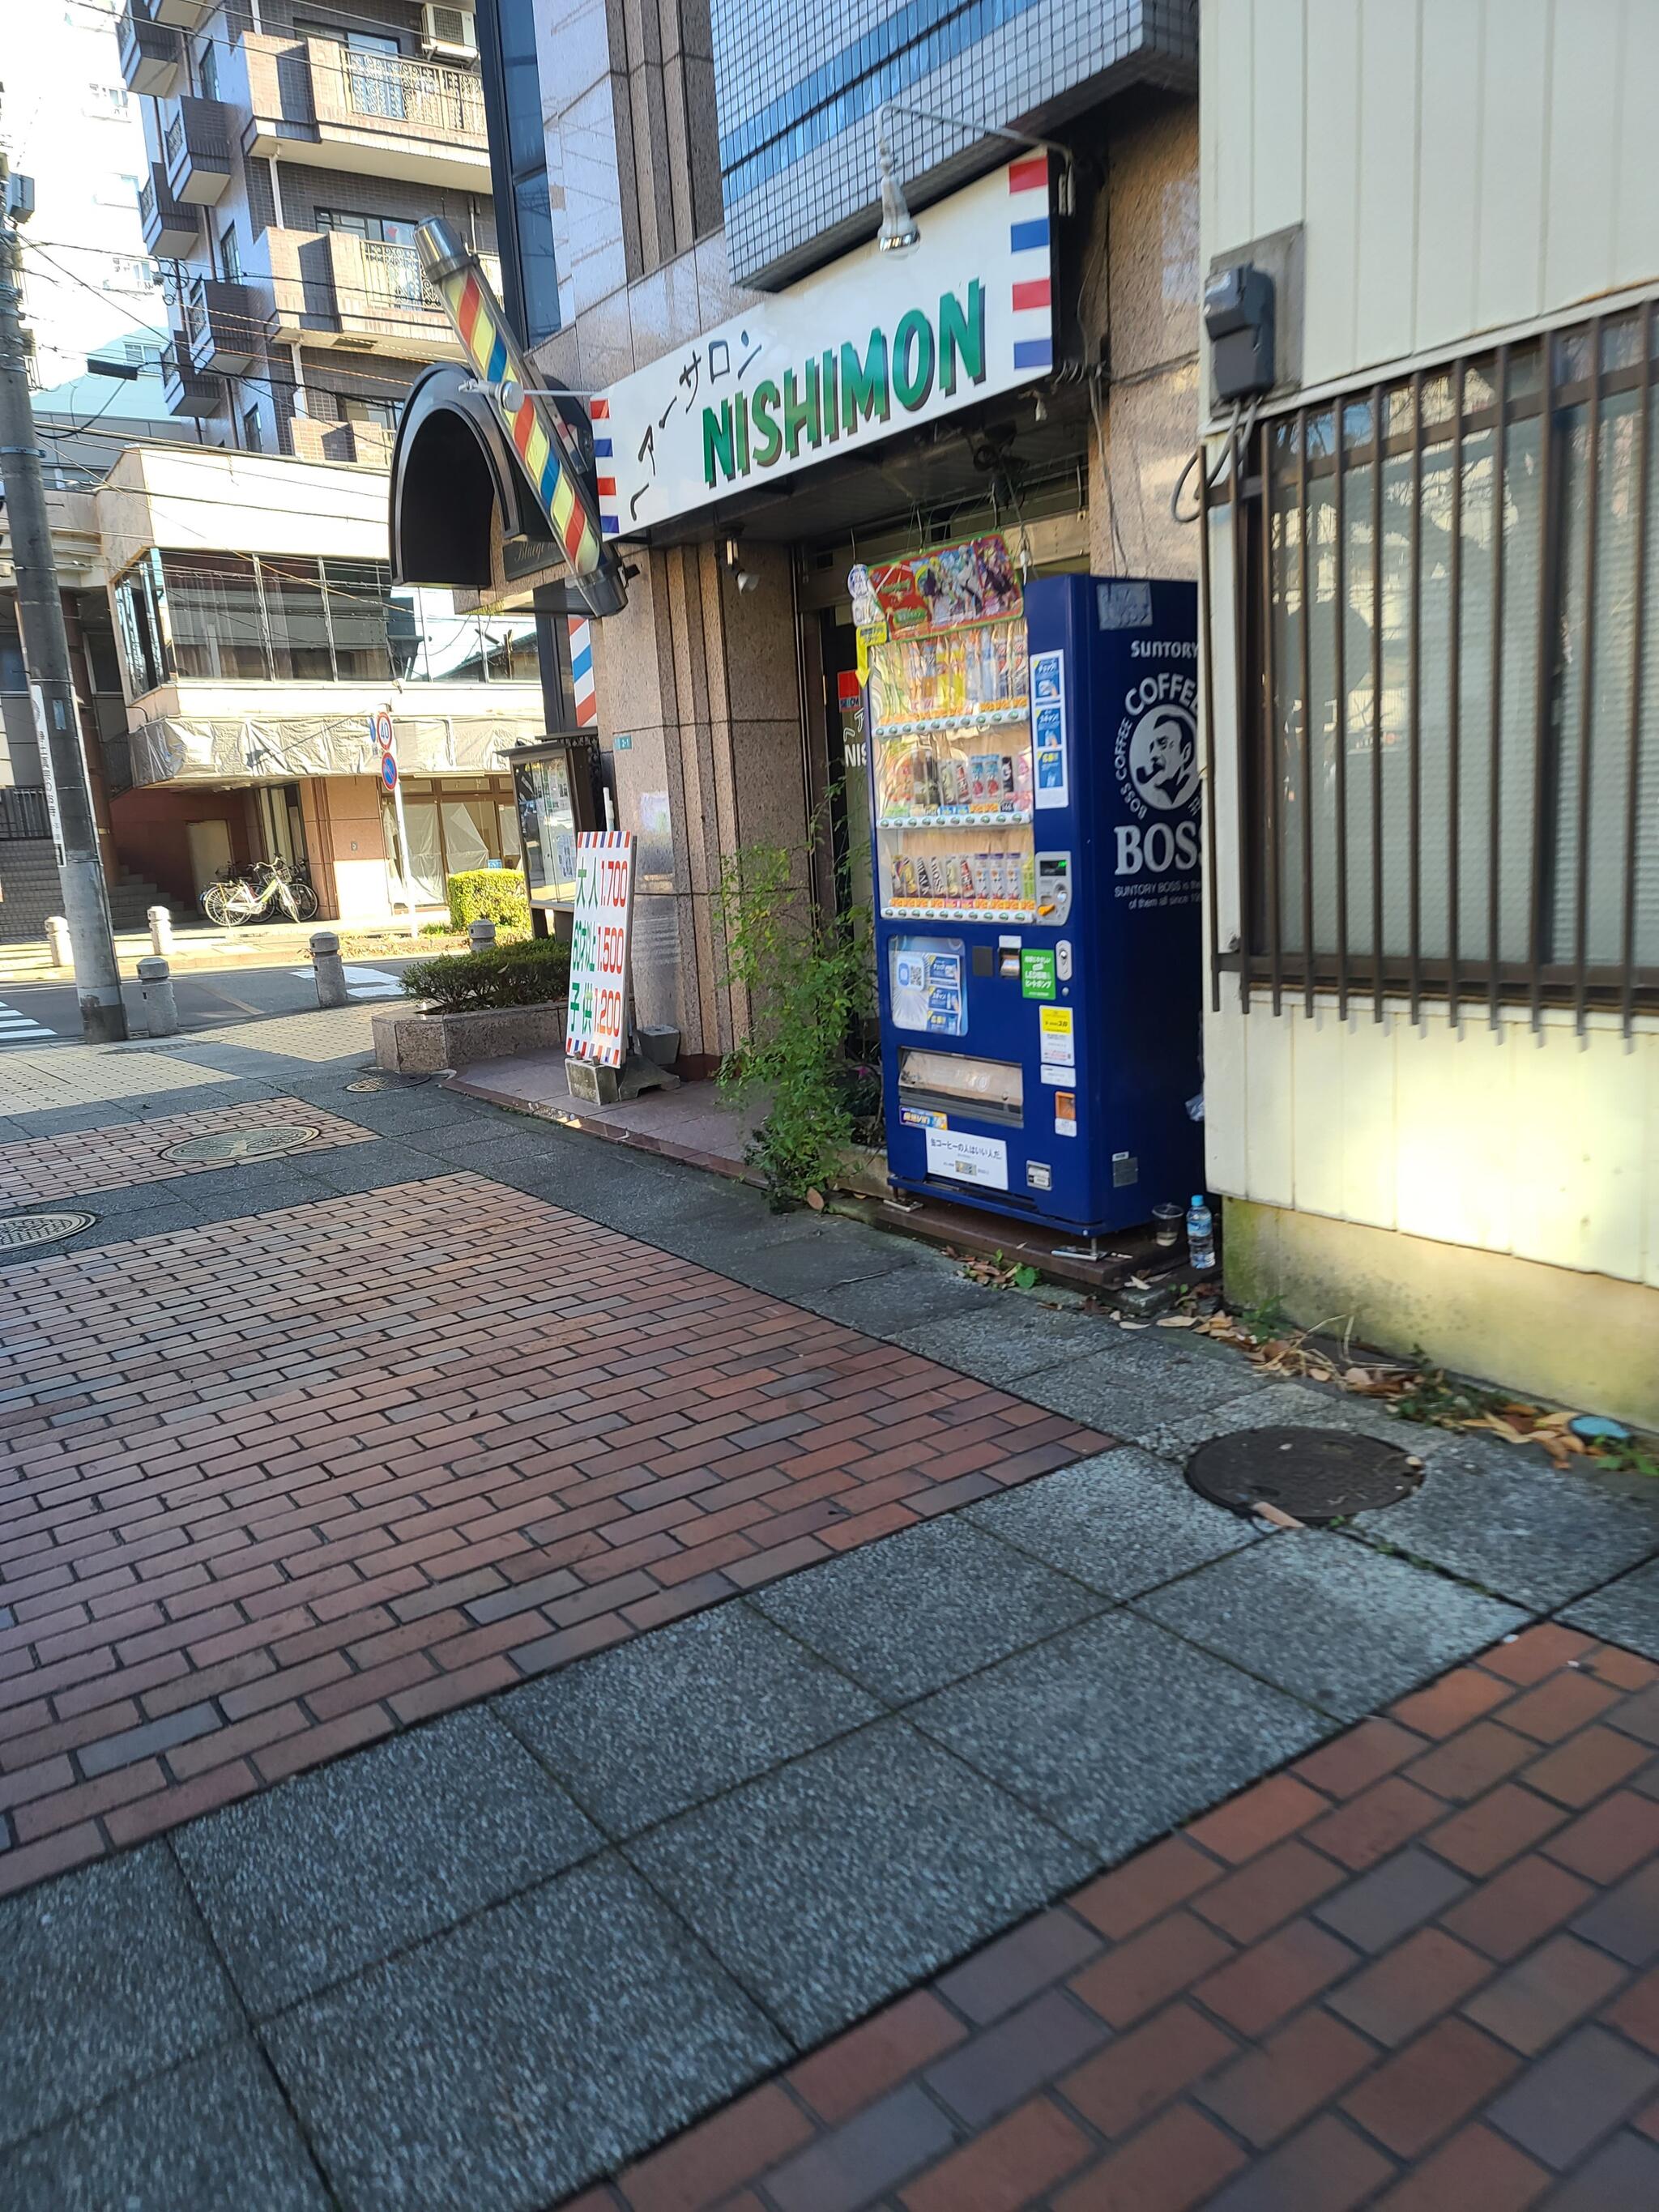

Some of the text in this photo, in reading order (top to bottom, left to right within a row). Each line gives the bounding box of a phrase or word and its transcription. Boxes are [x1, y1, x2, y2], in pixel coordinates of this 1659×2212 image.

[702, 276, 986, 490] NISHIMON
[629, 329, 762, 522] ヘアーサロン
[381, 722, 390, 739] 40
[1113, 820, 1201, 876] BOS
[576, 856, 598, 909] 大人
[570, 982, 593, 1035] 子供
